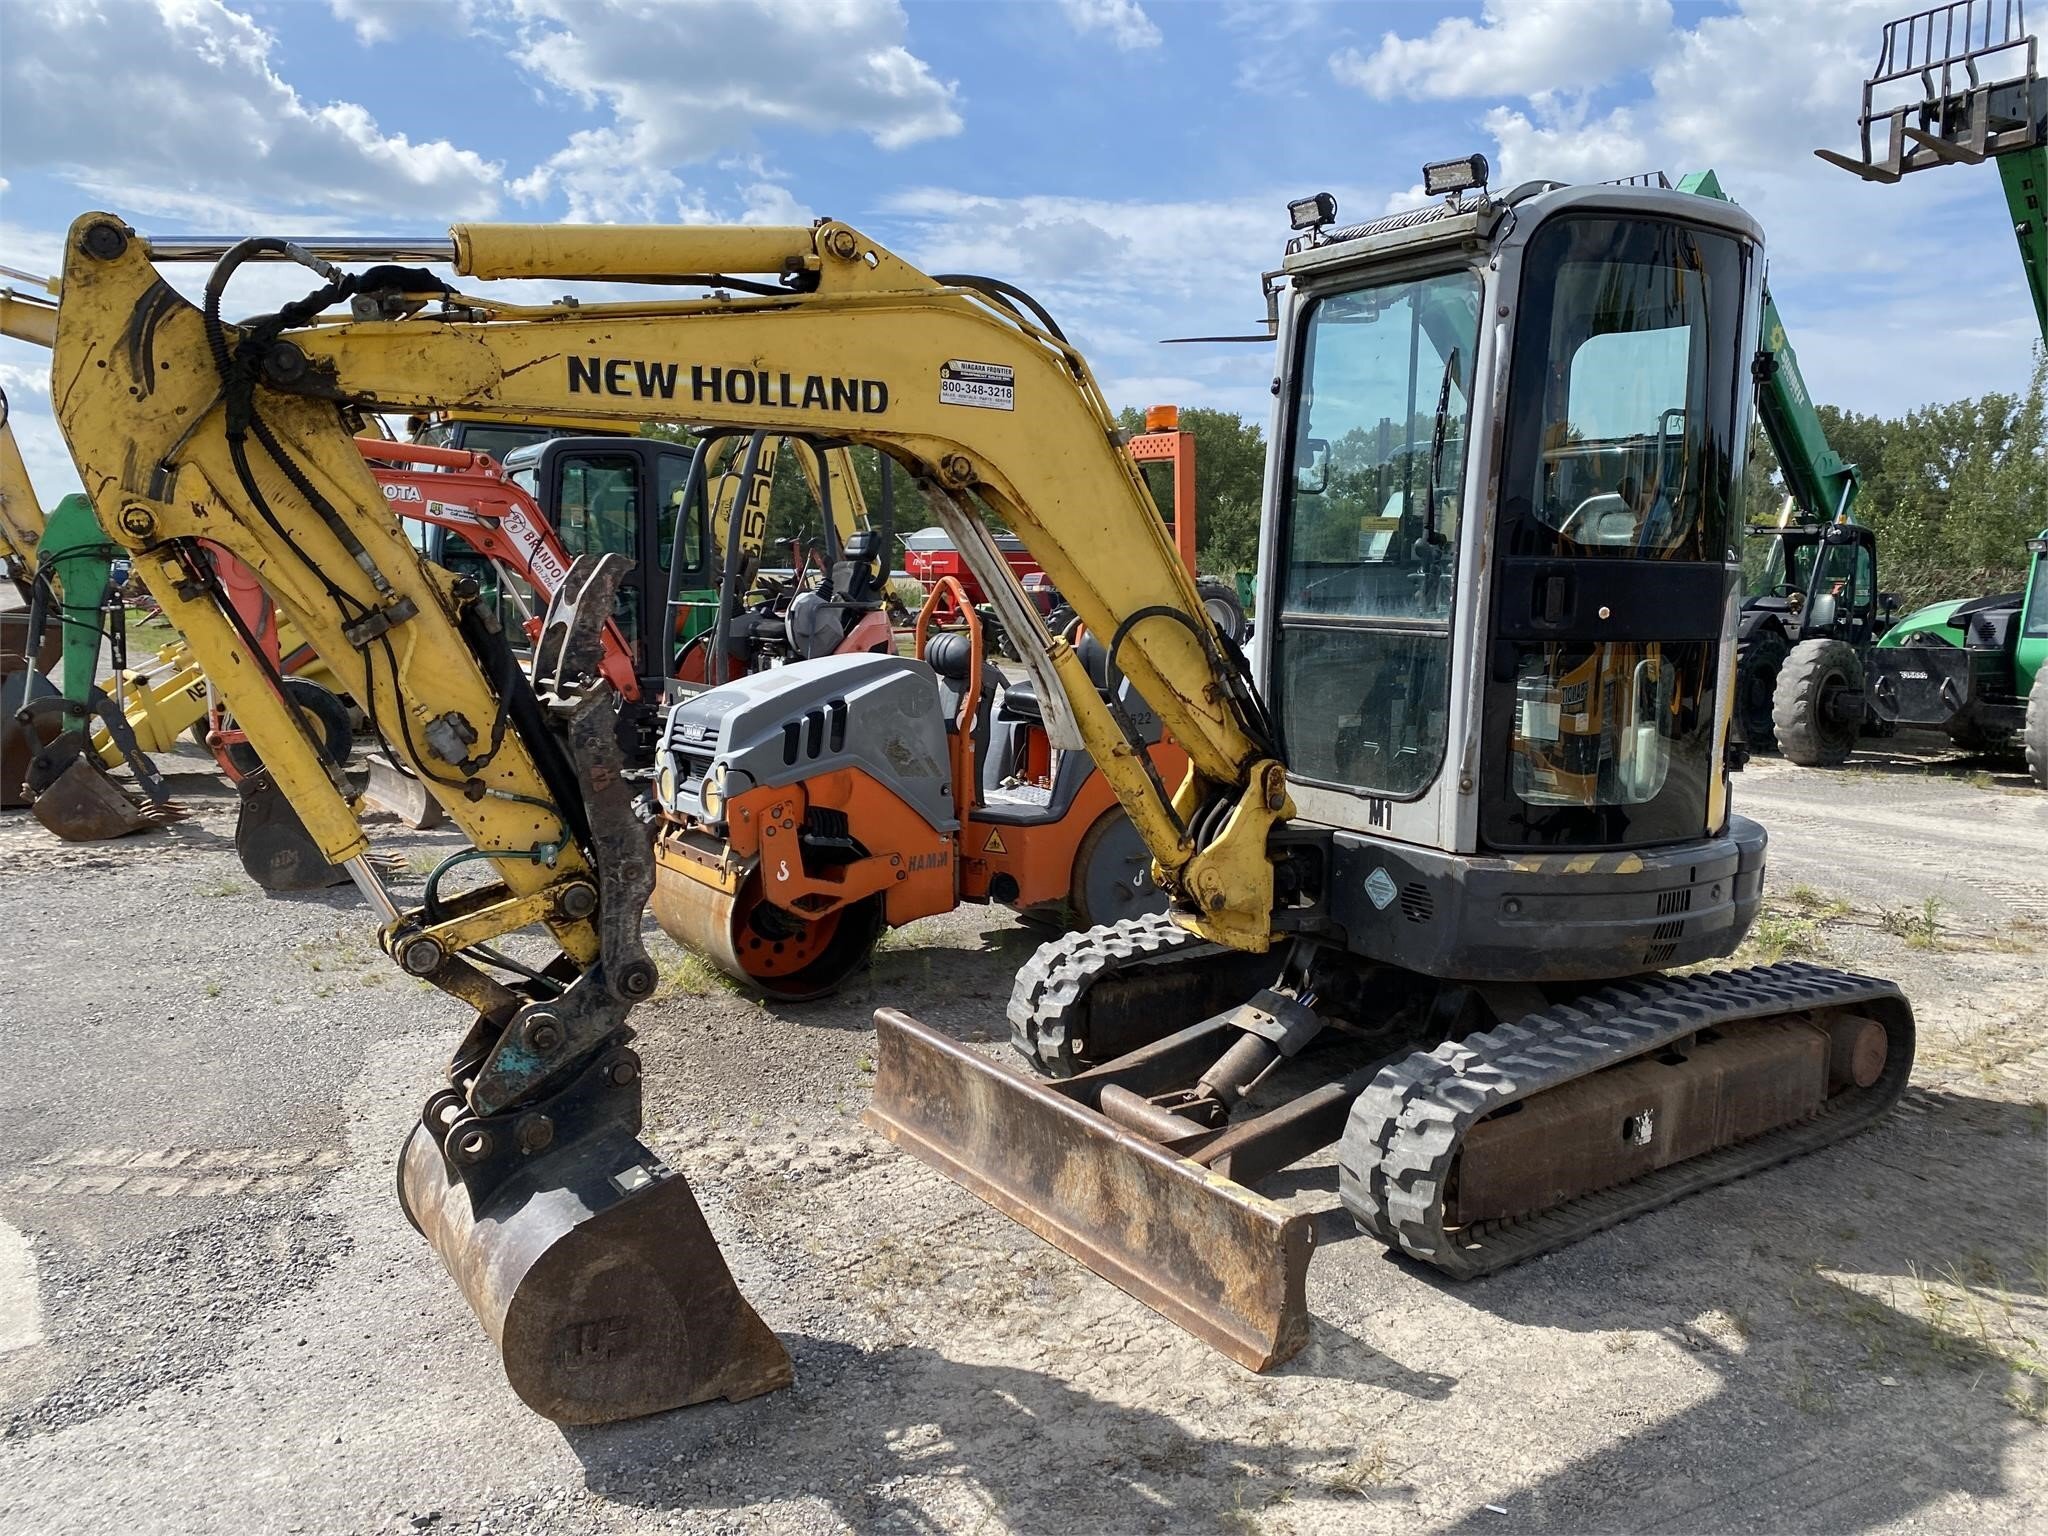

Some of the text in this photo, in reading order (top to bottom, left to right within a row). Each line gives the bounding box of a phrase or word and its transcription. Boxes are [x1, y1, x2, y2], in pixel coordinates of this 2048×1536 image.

[960, 362, 1012, 375] NIAGARA FRONTIER
[567, 356, 889, 413] NEW HOLLAND
[942, 381, 1012, 398] 800-348-3218
[379, 482, 421, 502] OTA
[1369, 799, 1392, 831] M1
[908, 851, 948, 872] HAMM
